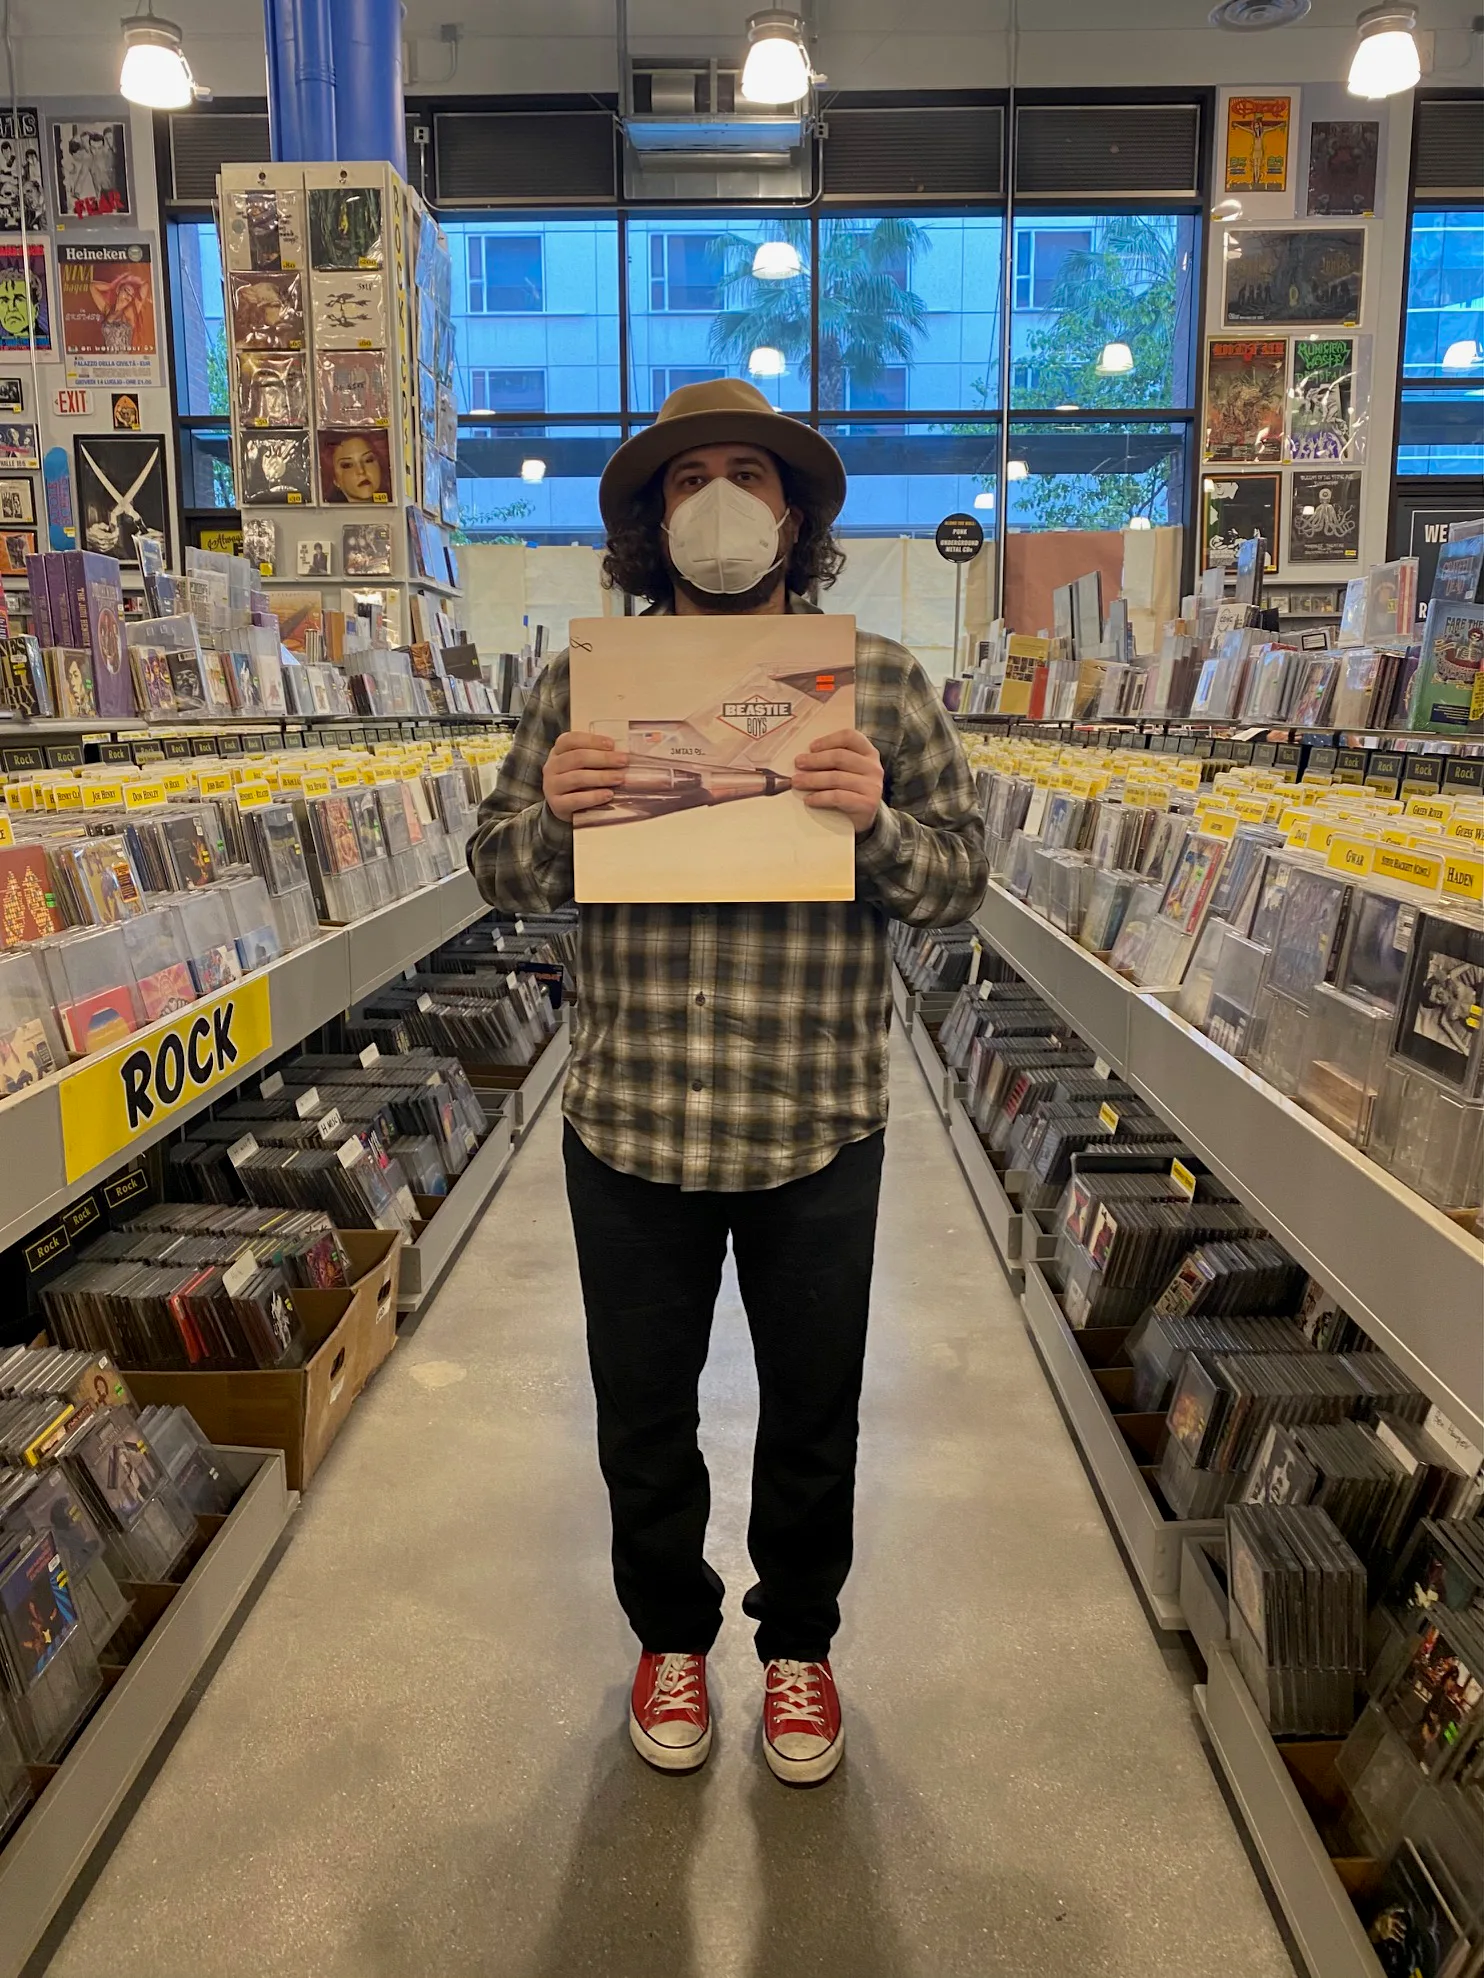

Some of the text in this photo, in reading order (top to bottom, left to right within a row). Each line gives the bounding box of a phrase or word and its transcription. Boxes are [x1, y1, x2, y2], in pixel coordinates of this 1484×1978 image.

[74, 188, 124, 219] FEAR
[66, 248, 127, 260] Heineken
[63, 264, 95, 281] NINA
[58, 390, 87, 413] EXIT
[1425, 524, 1448, 543] WE
[77, 587, 86, 602] THE
[724, 704, 789, 716] BEASTIE
[747, 717, 767, 737] BOYS
[108, 749, 125, 760] Rock
[171, 744, 184, 753] Rock
[199, 743, 212, 752] Rock
[13, 753, 35, 766] Rock
[57, 751, 76, 763] Rock
[1344, 757, 1359, 768] Rock
[1377, 761, 1394, 772] Rock
[1414, 763, 1433, 776] Rock
[1454, 766, 1476, 780] Rock
[92, 790, 116, 803] JOE HENRY
[132, 790, 159, 802] DON HENLEY
[1413, 804, 1443, 819] GREEN RIVER
[1455, 825, 1473, 839] GUESS
[1345, 849, 1365, 866] GWAR
[1394, 857, 1413, 873] HACKETT
[1446, 866, 1475, 887] HADEN
[120, 1003, 238, 1129] ROCK
[321, 1123, 328, 1136] H
[115, 1178, 138, 1197] Rock
[72, 1206, 91, 1226] Rock
[37, 1236, 60, 1258] Rock
